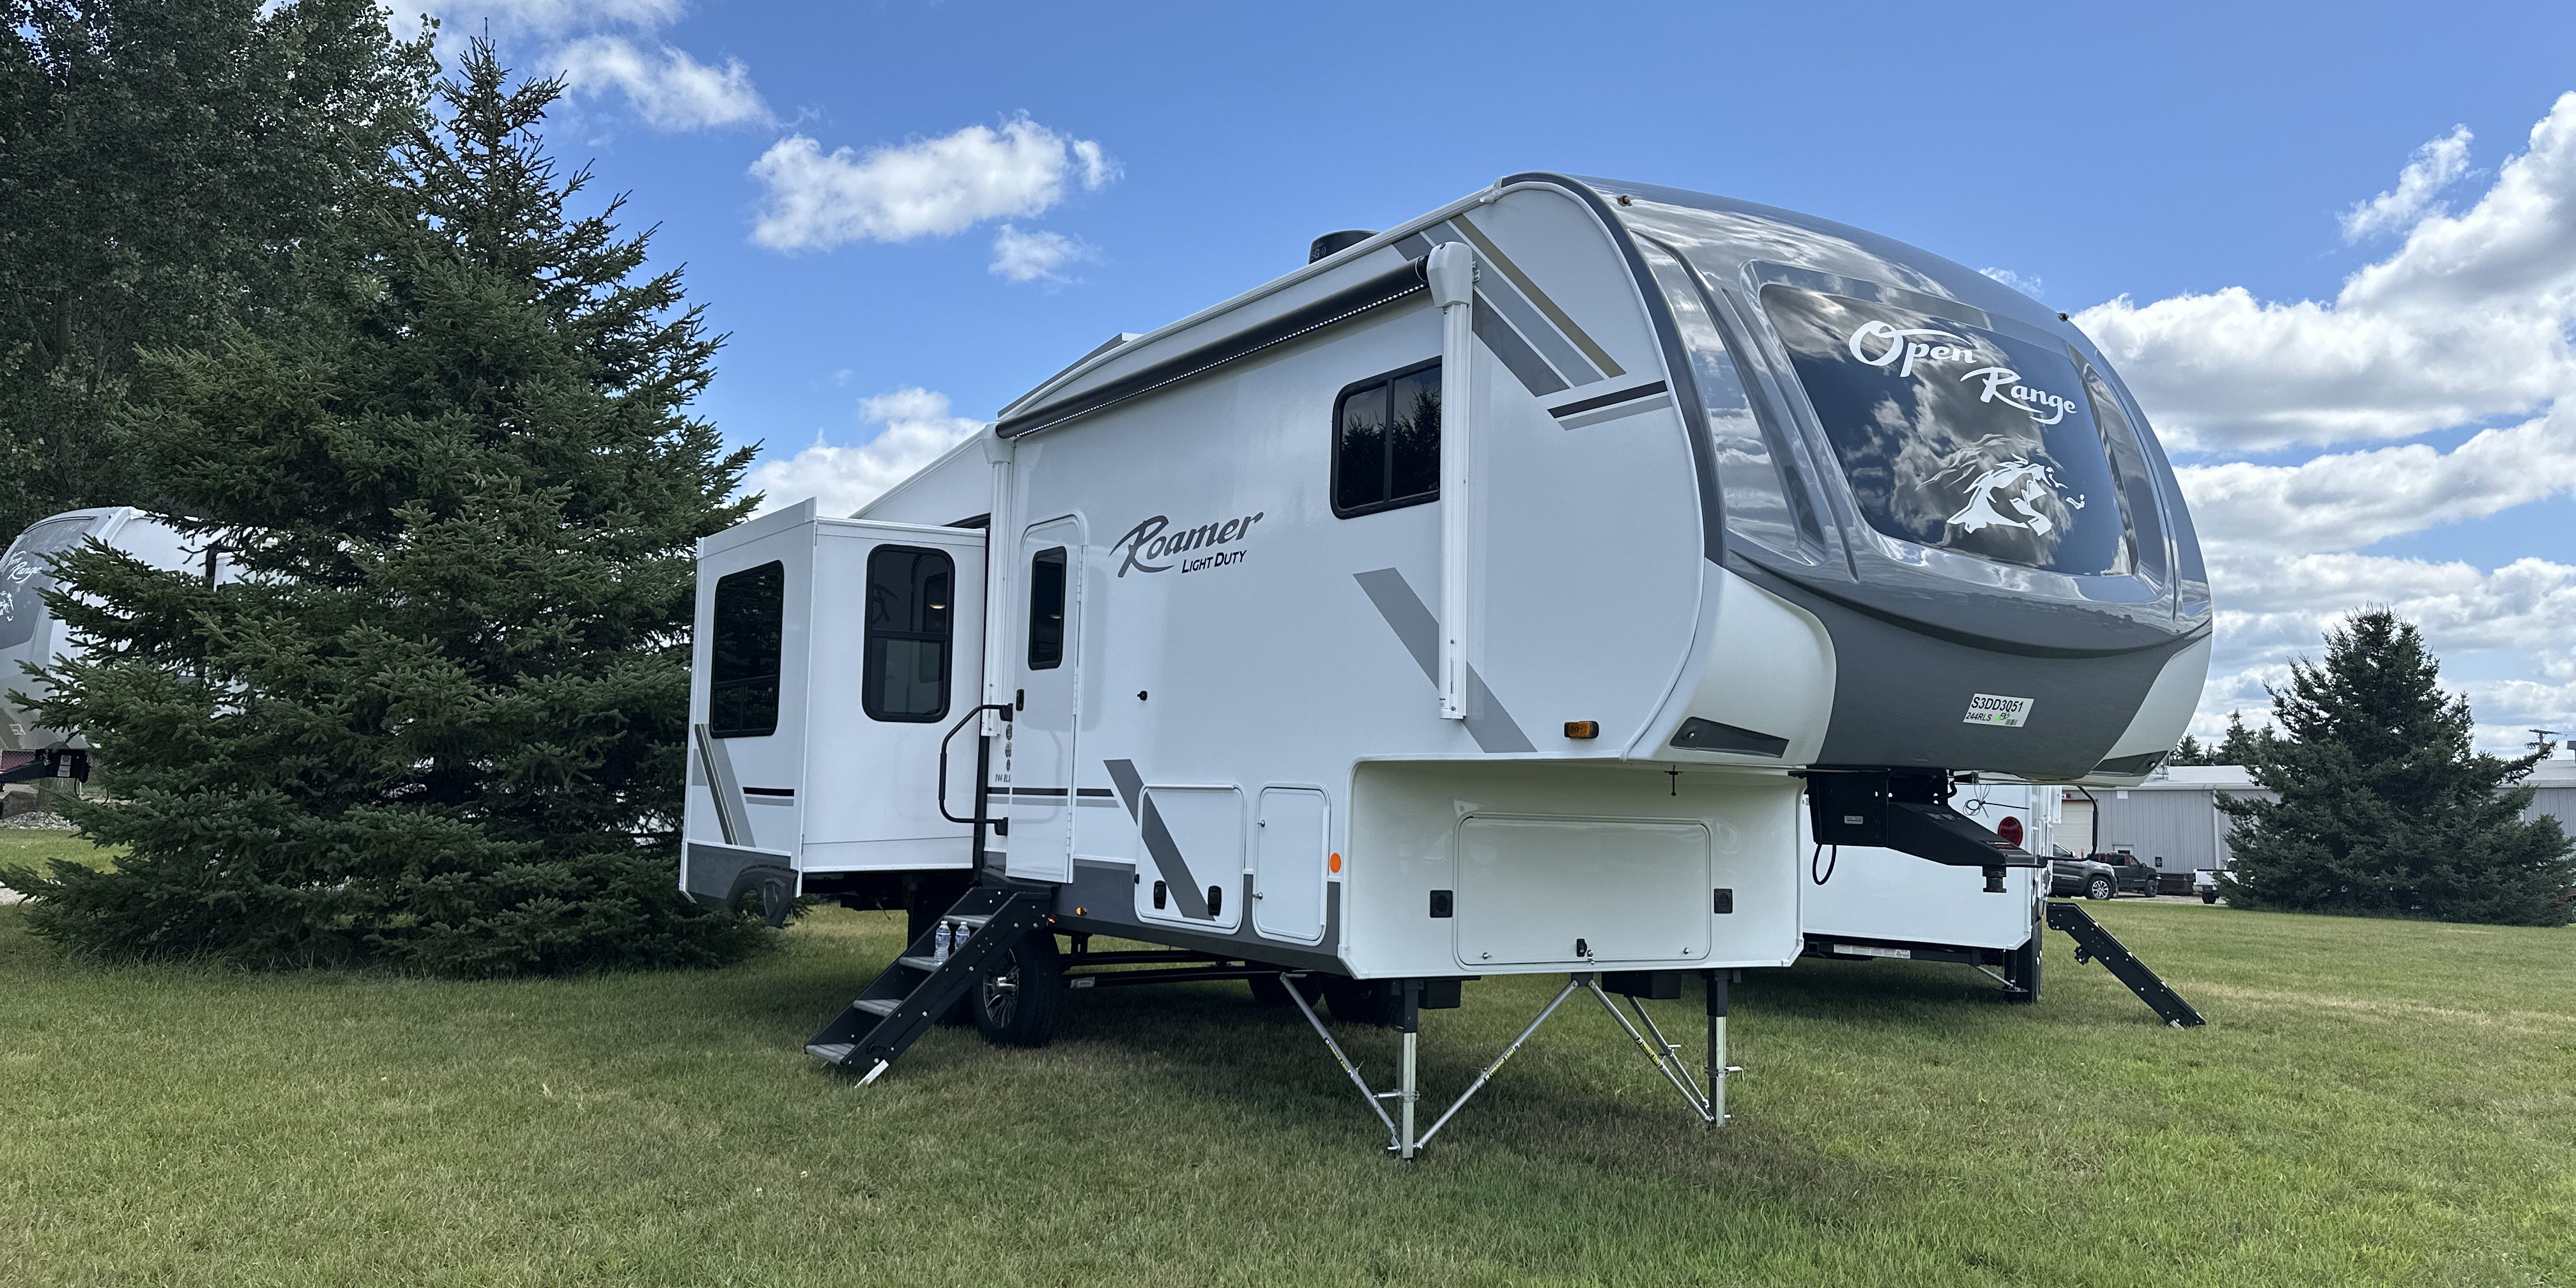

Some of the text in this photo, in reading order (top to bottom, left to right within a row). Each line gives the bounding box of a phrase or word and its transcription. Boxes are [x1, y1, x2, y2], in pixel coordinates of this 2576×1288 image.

[1849, 320, 1977, 378] Open
[1960, 366, 2078, 425] Range
[1109, 511, 1264, 578] Roamer
[6, 561, 43, 584] Range
[1181, 550, 1247, 574] LIGHT DUTY
[1965, 712, 1993, 721] 244RLS
[1971, 696, 2024, 713] S3DD3051
